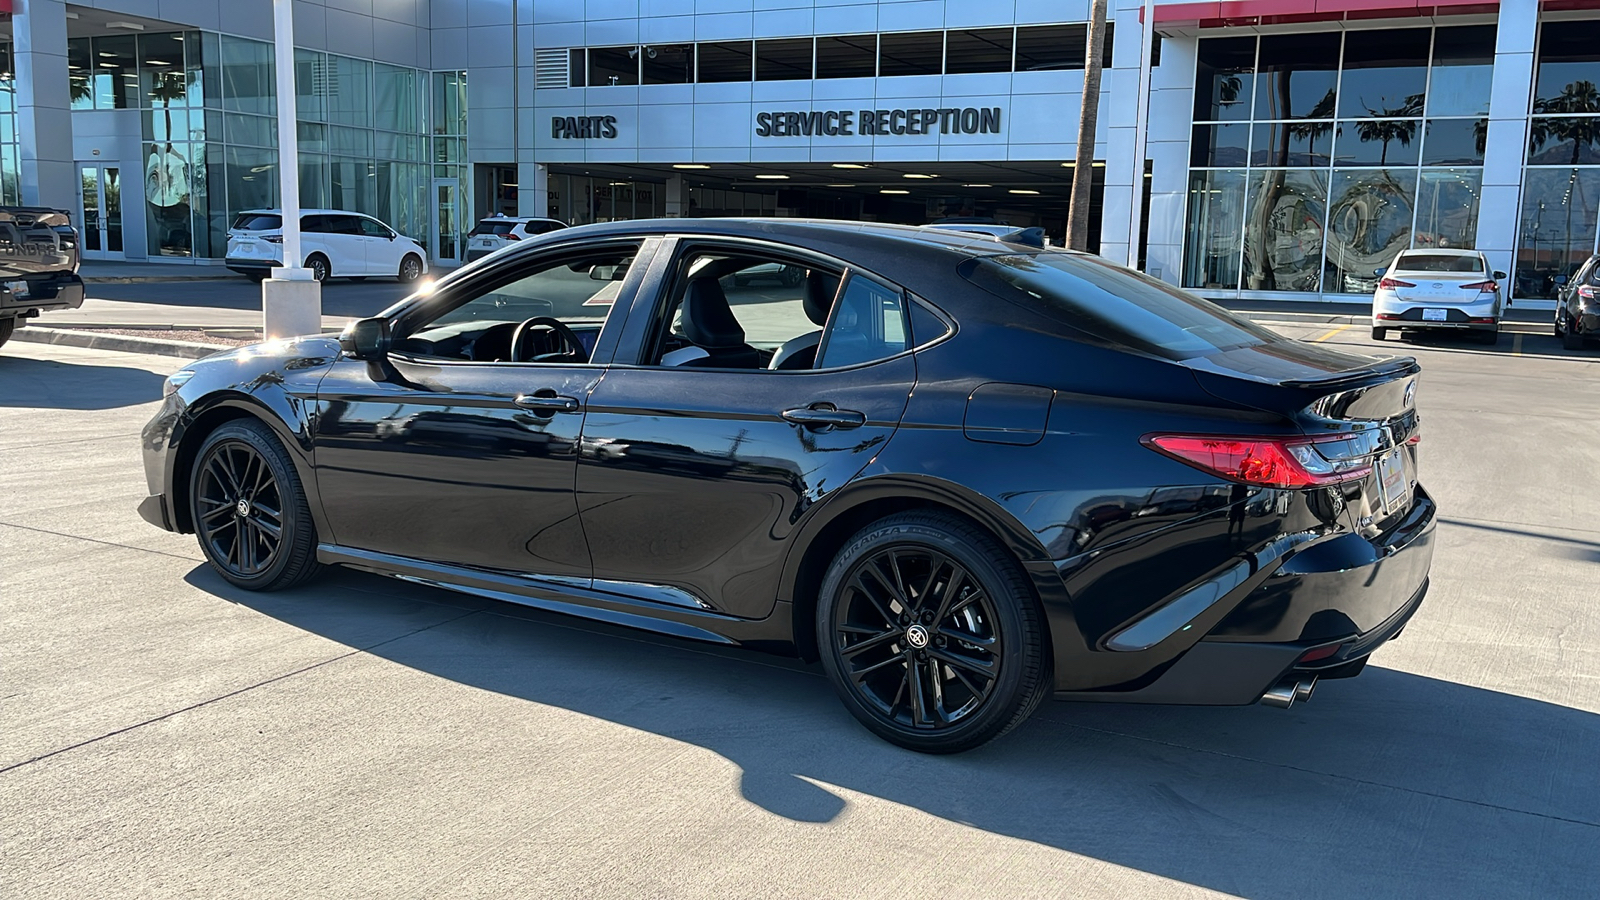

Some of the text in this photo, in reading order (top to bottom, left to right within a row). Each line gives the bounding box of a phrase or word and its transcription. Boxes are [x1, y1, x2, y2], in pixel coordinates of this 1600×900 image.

[551, 115, 617, 139] PARTS
[756, 107, 1001, 137] SERVICE RECEPTION
[626, 189, 652, 200] TYOT
[836, 526, 902, 568] TURANZA
